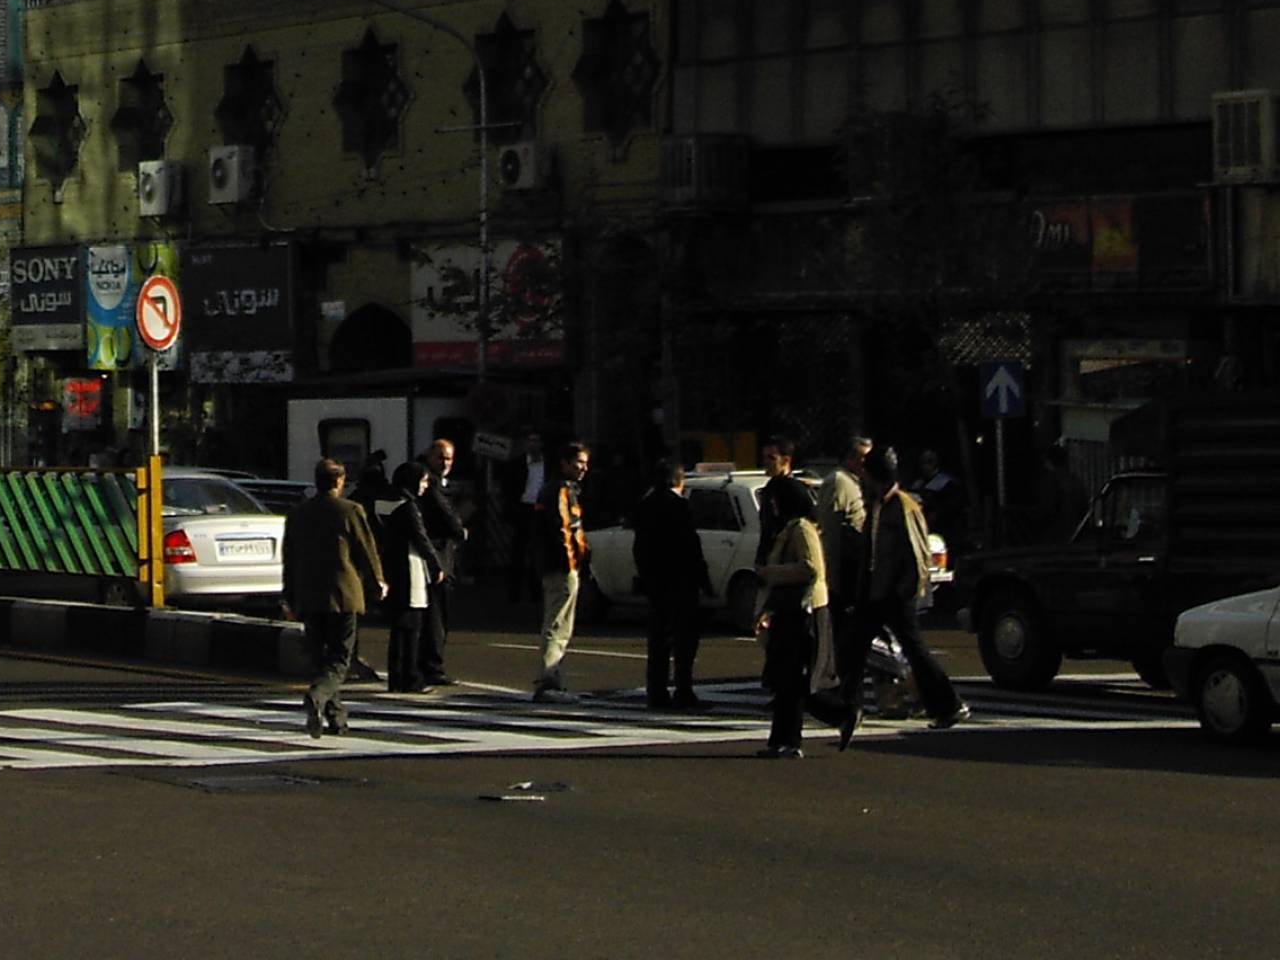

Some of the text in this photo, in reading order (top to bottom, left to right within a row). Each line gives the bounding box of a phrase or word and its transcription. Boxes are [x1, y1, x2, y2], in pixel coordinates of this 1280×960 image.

[12, 256, 78, 284] SONY
[20, 290, 72, 313] سونی
[202, 287, 280, 317] سونی
